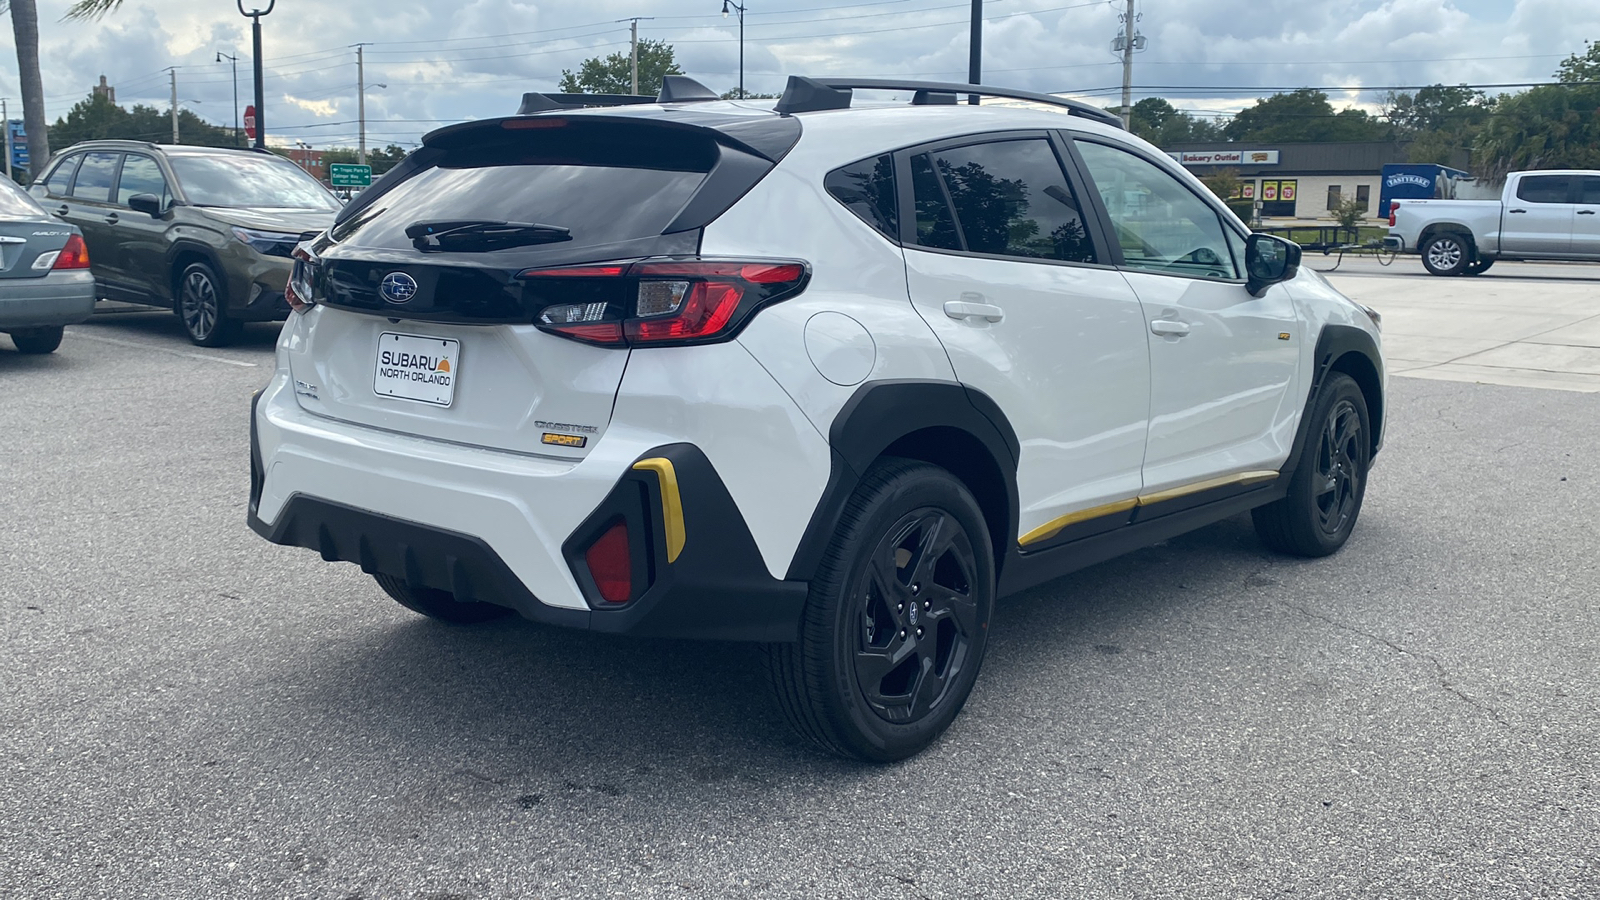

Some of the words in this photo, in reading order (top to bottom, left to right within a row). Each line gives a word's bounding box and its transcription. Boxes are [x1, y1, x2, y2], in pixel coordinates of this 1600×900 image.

[244, 116, 256, 129] STO
[1183, 154, 1212, 163] Bakery
[1214, 153, 1240, 161] Outlet
[1387, 176, 1430, 187] TASTYKAKE
[381, 351, 438, 371] SUBARU
[380, 367, 410, 380] NORTH
[411, 372, 451, 386] ORLANDO
[534, 420, 599, 434] CROSSTREK
[544, 434, 581, 445] SPORT
